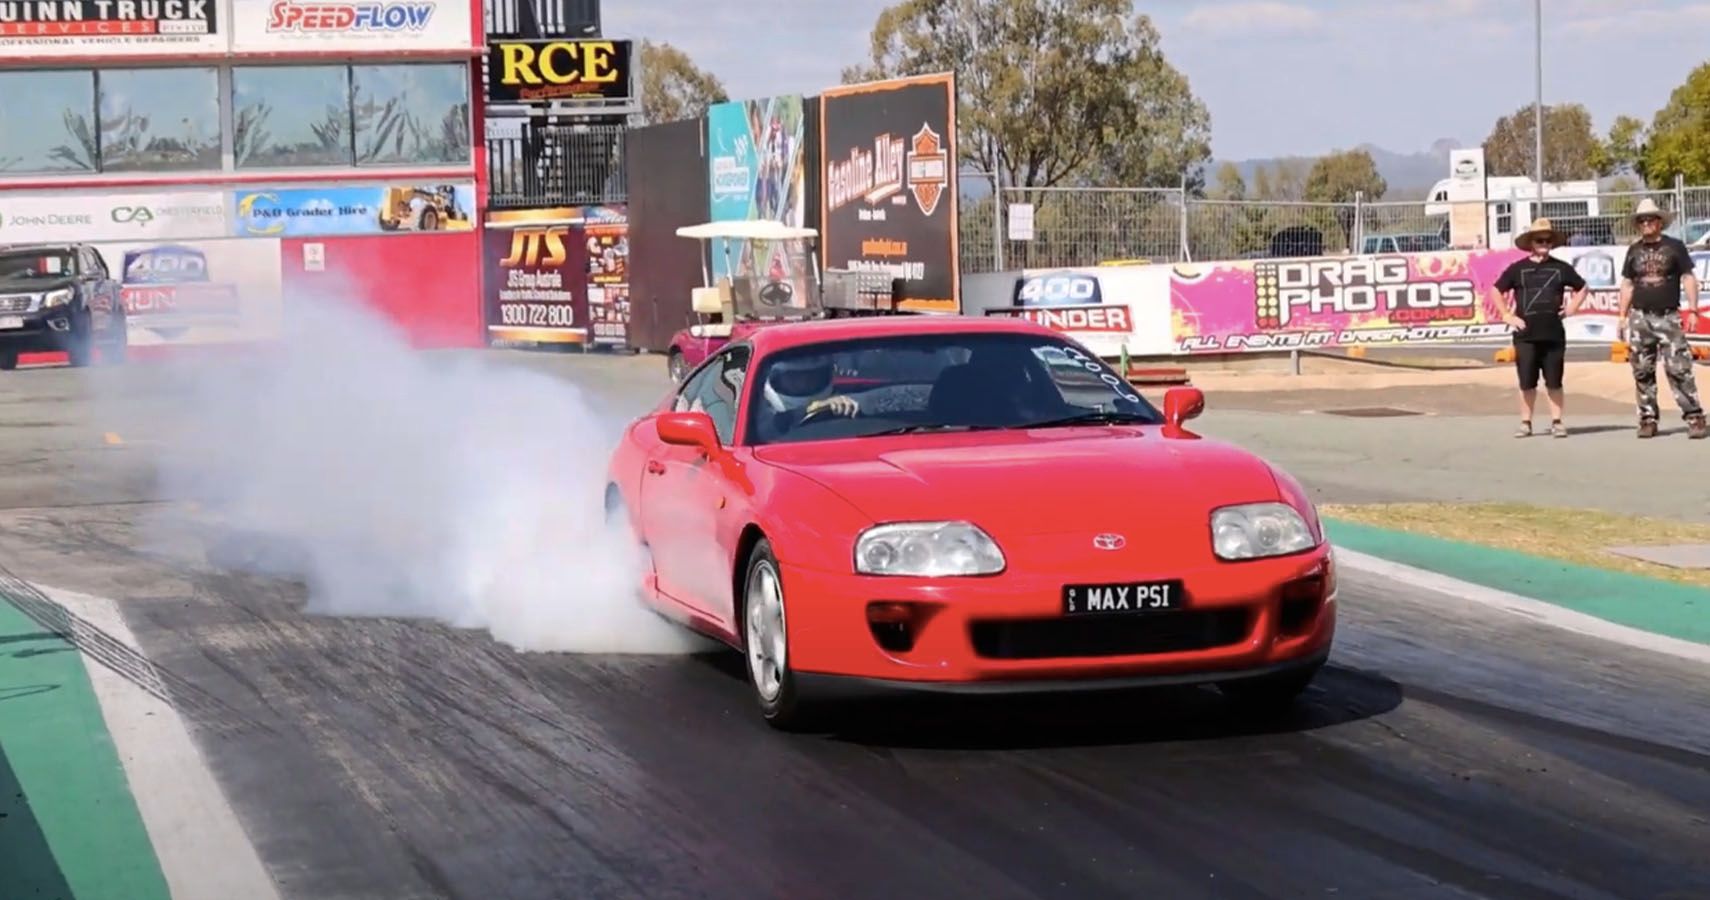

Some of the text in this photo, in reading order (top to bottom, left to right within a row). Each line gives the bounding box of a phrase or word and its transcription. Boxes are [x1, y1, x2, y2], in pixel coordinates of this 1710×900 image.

[95, 0, 207, 20] TRUCK
[269, 1, 433, 30] SPEEDFLOW
[500, 42, 618, 84] RCE
[9, 213, 92, 226] JOHN DEERE
[287, 207, 334, 217] Grader
[339, 205, 368, 215] Hire
[500, 226, 569, 267] JTS
[1278, 258, 1408, 288] DRAG
[1018, 277, 1094, 302] 400
[501, 303, 574, 326] 1300 722 800
[1279, 281, 1474, 325] PHOTOS
[1183, 336, 1221, 350] ALL
[1226, 333, 1302, 348] EVENTS
[1306, 331, 1335, 344] AT
[1087, 584, 1169, 610] MAX PSI
